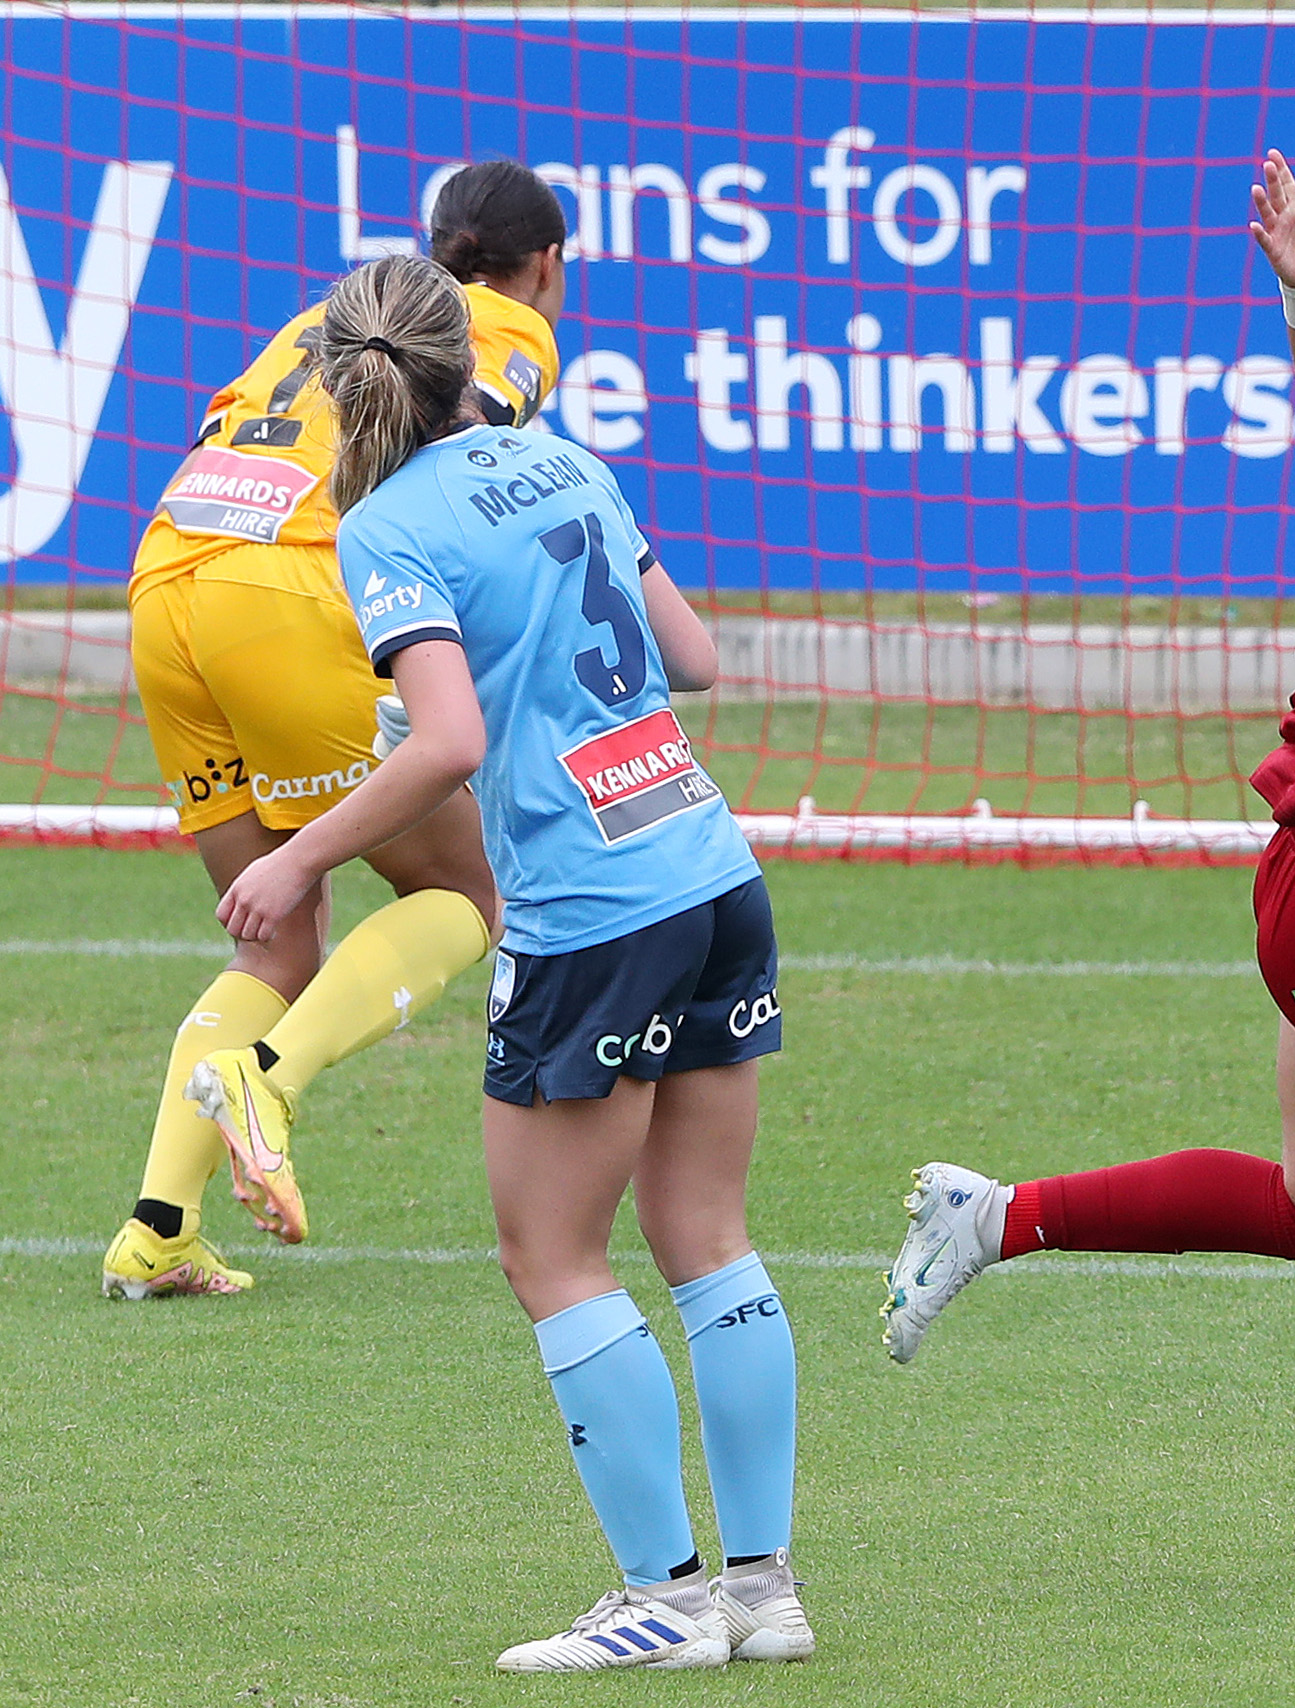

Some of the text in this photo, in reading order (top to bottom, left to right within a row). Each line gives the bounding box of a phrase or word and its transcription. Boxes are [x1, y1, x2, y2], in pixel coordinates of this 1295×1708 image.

[810, 126, 1028, 267] for
[172, 472, 292, 508] ENNARDS
[219, 509, 276, 535] HIRE
[359, 582, 423, 628] berty
[536, 512, 646, 706] 3
[252, 760, 374, 802] Carma
[717, 1298, 778, 1328] SFC
